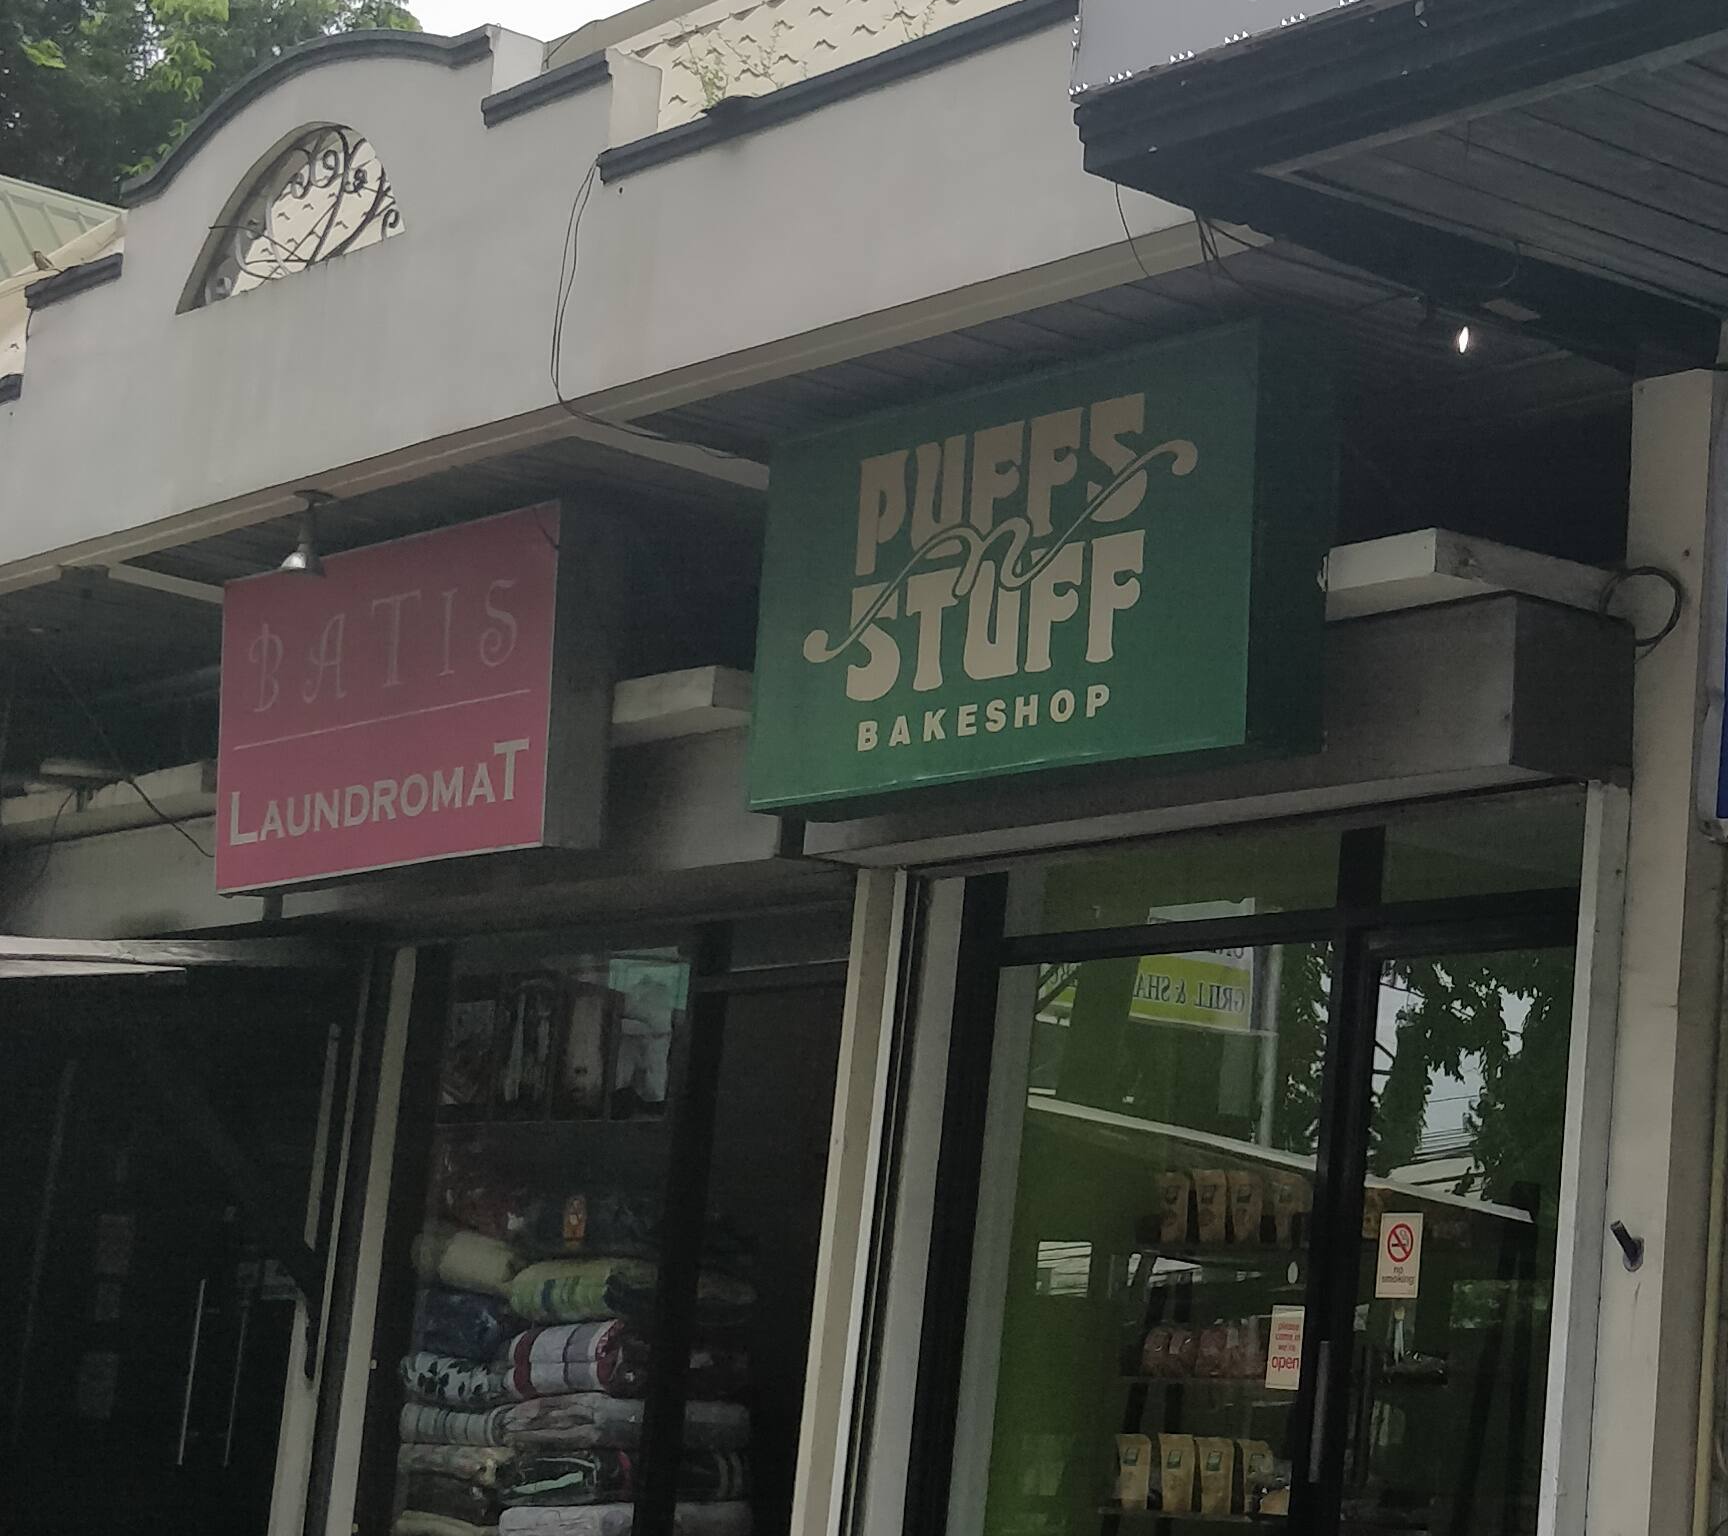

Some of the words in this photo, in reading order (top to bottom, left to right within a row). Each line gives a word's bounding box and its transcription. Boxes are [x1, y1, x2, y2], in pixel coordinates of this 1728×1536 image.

[854, 392, 1148, 577] PUFFS
[248, 578, 519, 713] BATIS
[845, 528, 1146, 702] STUFF
[856, 683, 1111, 753] BAKESHOP
[229, 737, 530, 846] LAUNDROMAT
[1381, 1275, 1416, 1286] smoking
[1393, 1266, 1404, 1274] no
[1271, 1355, 1300, 1372] open
